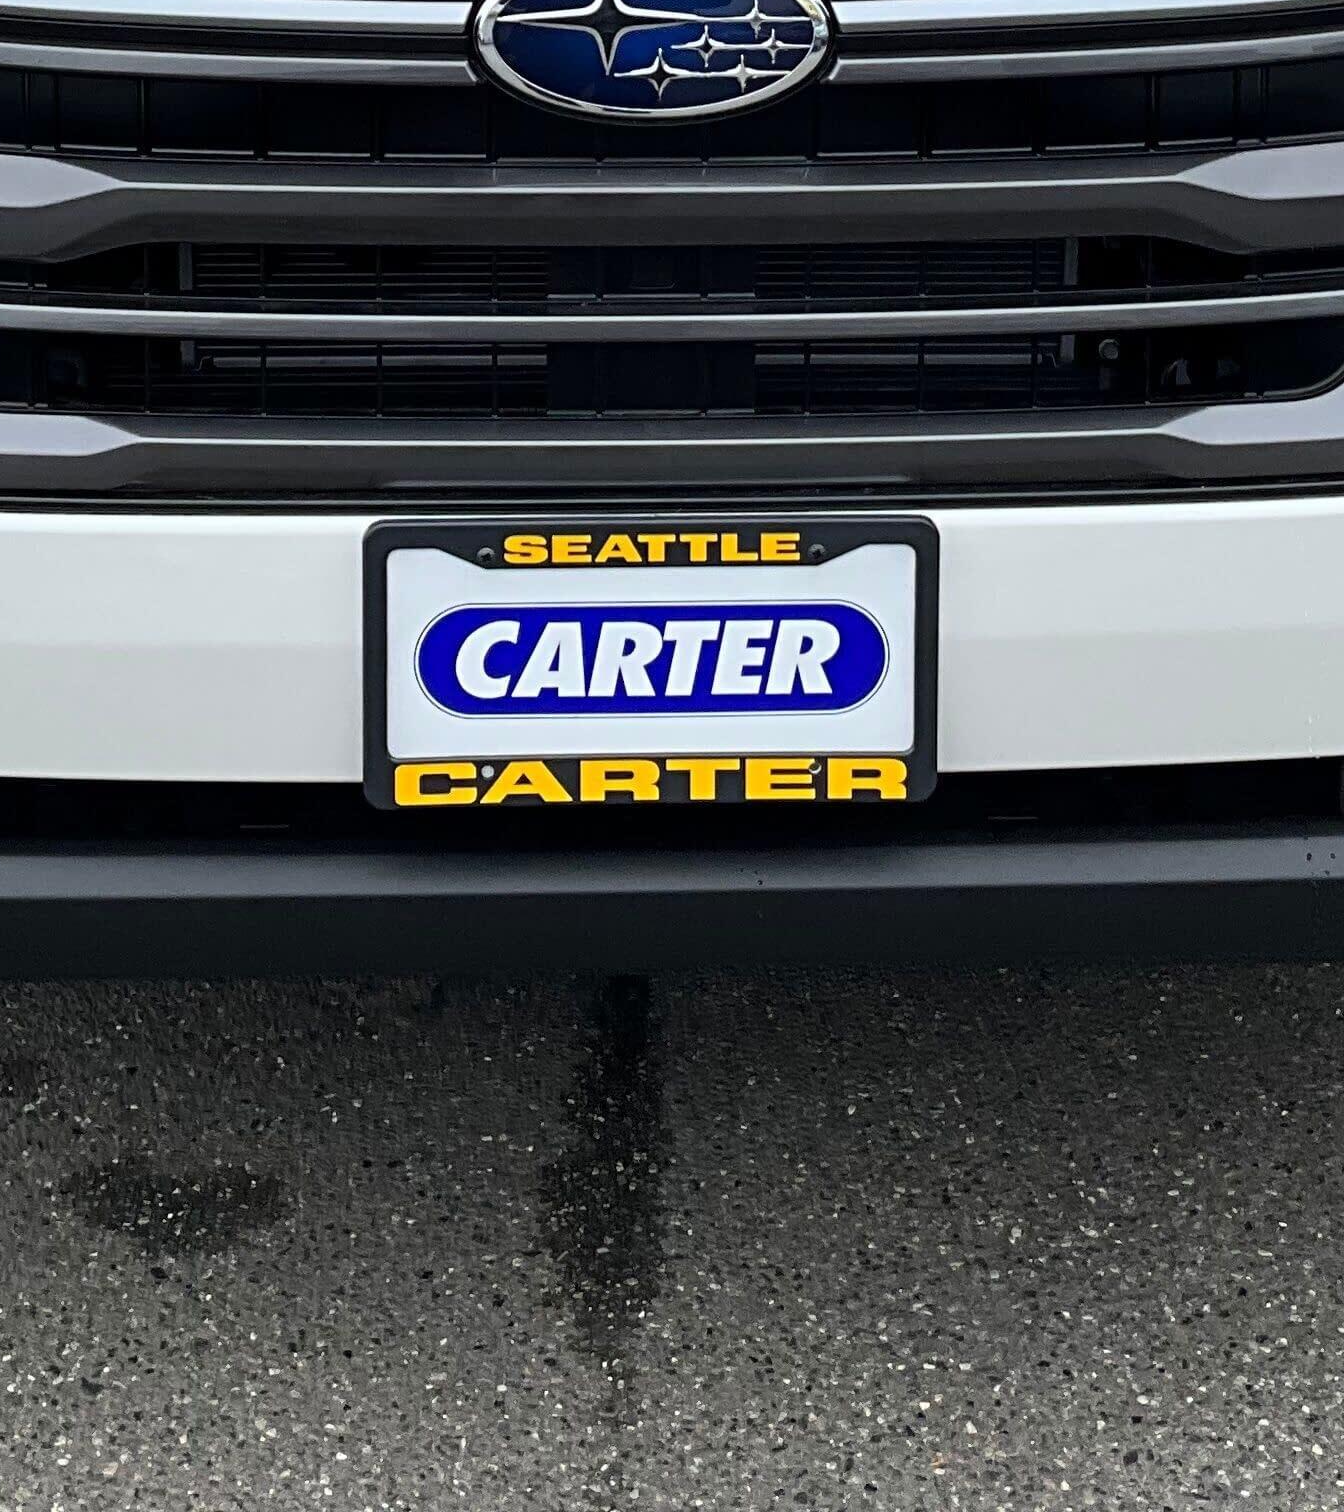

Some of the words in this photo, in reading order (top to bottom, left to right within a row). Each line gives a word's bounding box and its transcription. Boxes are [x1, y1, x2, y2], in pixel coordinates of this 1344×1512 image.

[503, 532, 801, 565] SEATTLE
[455, 619, 841, 700] CARTER
[394, 758, 908, 807] CARTER
